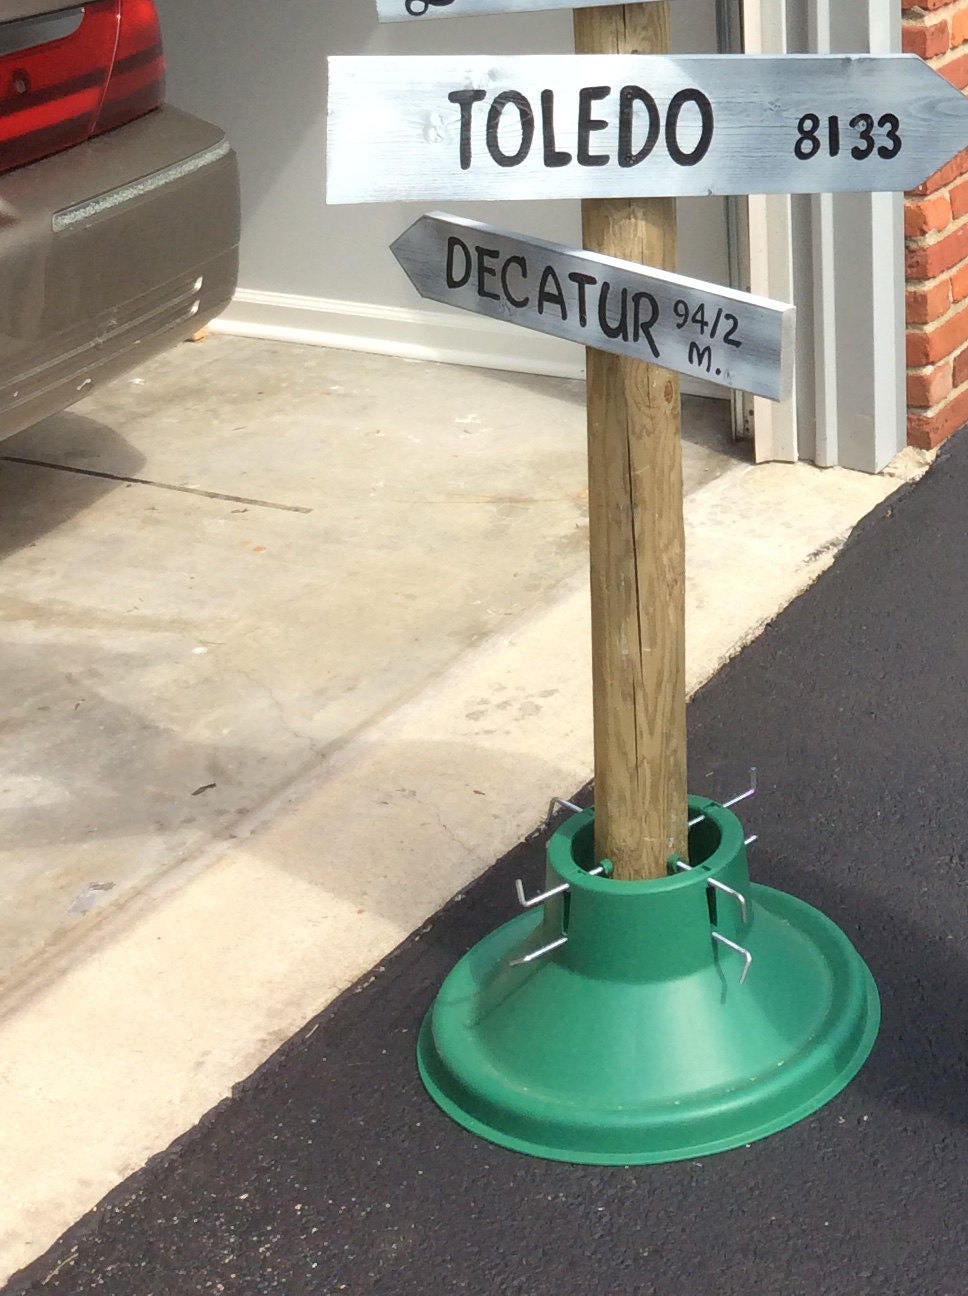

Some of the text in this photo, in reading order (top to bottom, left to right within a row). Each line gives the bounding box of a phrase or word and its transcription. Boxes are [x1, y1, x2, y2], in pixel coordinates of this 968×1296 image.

[448, 84, 716, 171] TOLEDO
[794, 112, 903, 162] 8133
[445, 236, 661, 359] DECATUR
